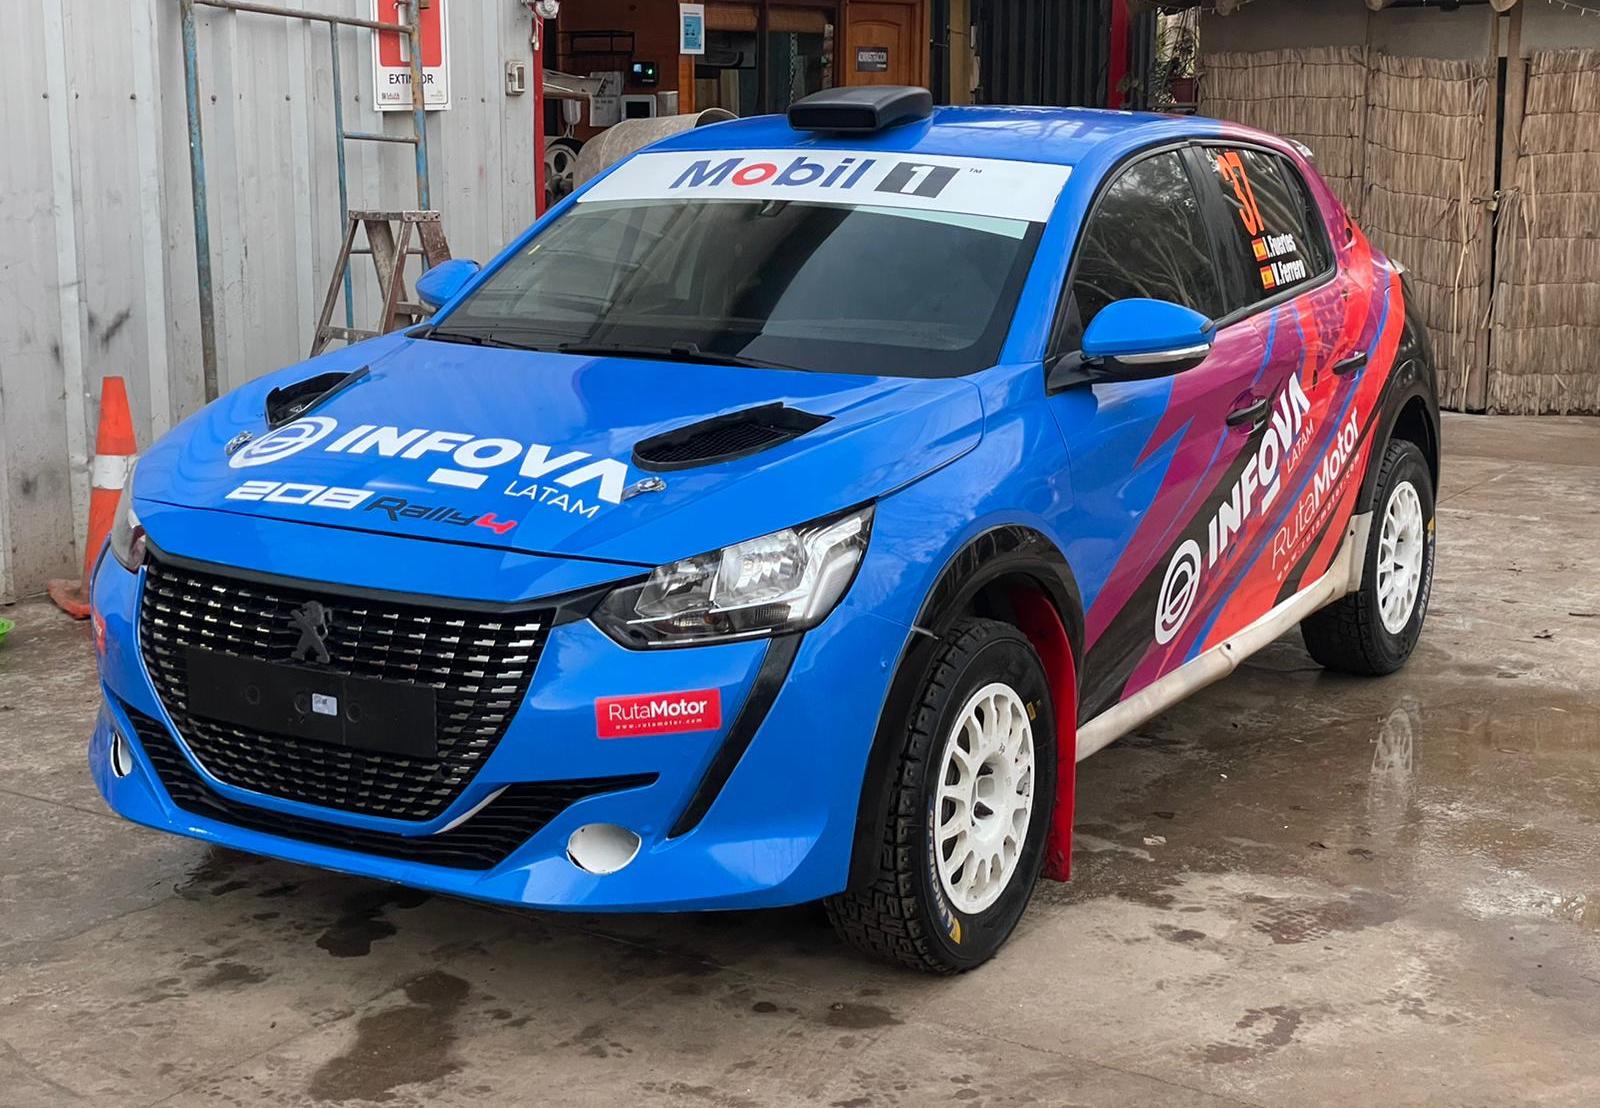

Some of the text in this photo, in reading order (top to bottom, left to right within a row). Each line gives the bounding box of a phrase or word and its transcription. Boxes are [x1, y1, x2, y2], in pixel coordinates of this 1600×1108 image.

[389, 73, 434, 84] EXTIOR
[669, 157, 876, 189] Mobil
[1217, 151, 1265, 236] 37
[1270, 259, 1306, 286] V.Ferrero
[324, 425, 628, 504] INFOVA
[1208, 371, 1311, 569] INFOVA
[1286, 418, 1315, 474] LATAM
[225, 480, 517, 534] 208 Rally4
[504, 480, 600, 519] LATAM
[1271, 406, 1360, 570] RutaMotor
[608, 698, 708, 721] RutaMotor
